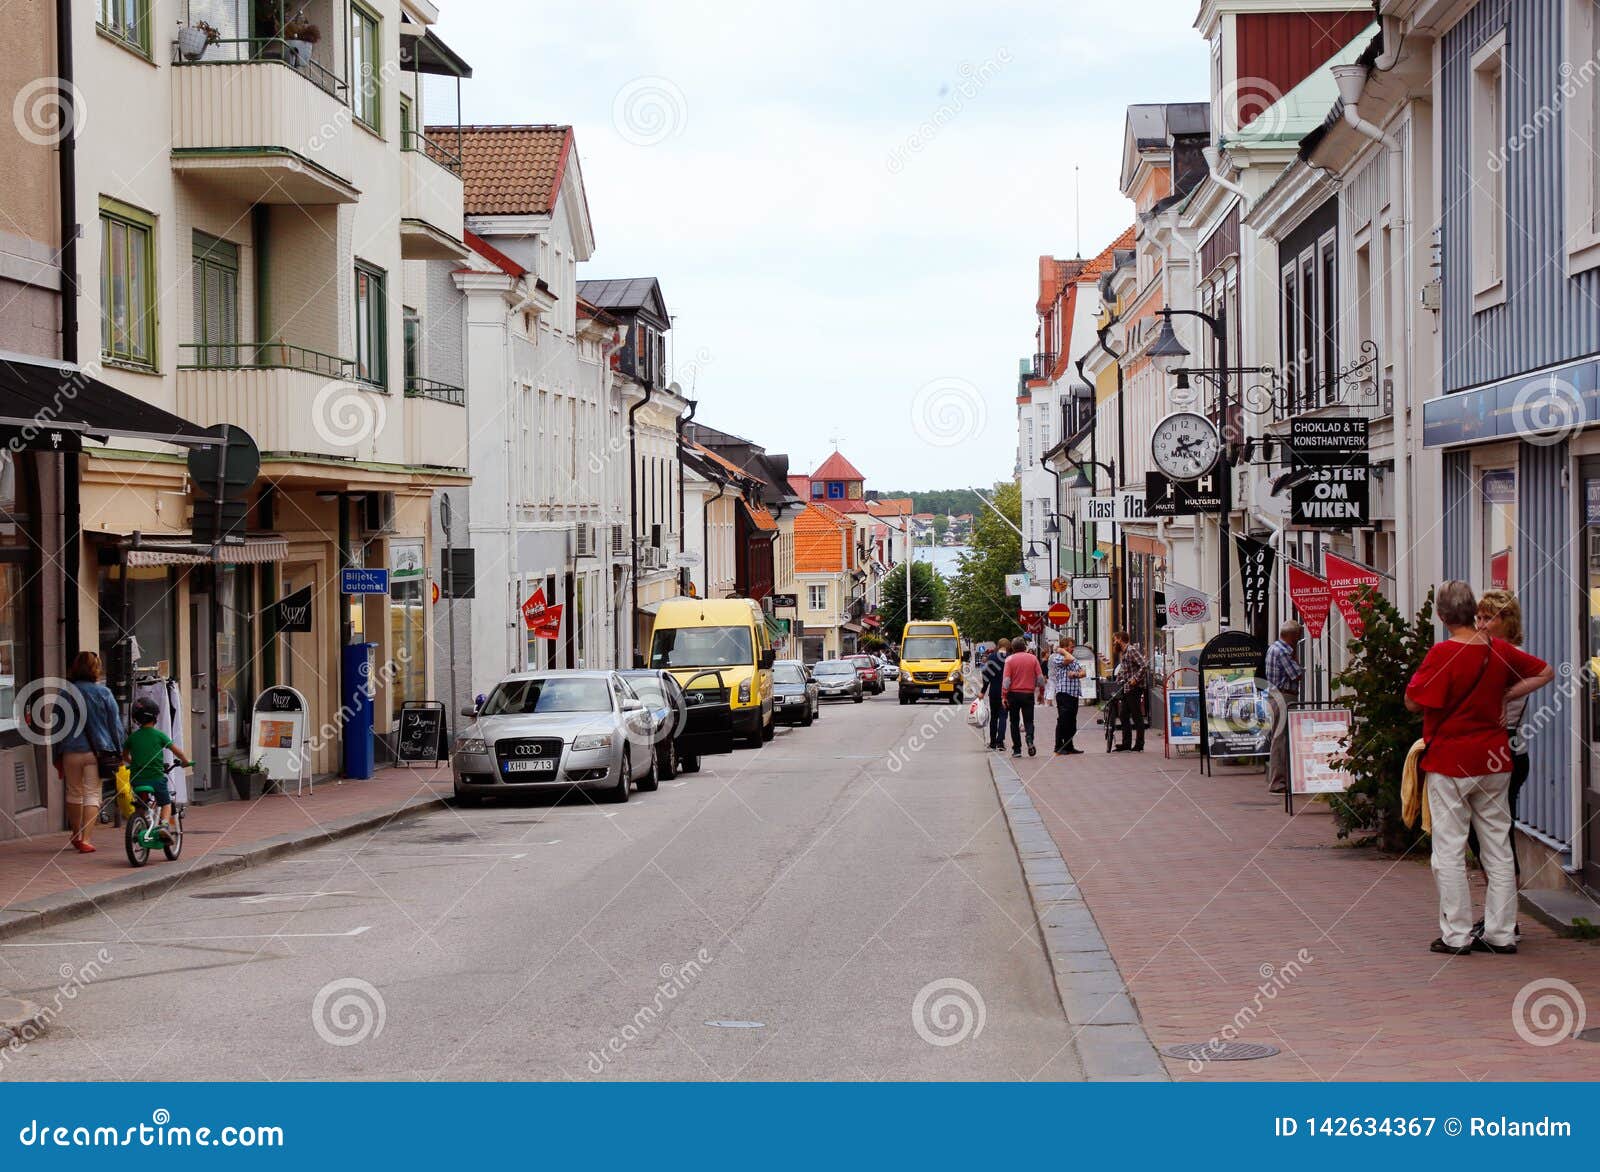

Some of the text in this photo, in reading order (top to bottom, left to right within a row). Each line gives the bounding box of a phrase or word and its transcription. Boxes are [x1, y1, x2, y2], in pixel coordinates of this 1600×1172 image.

[1294, 422, 1365, 432] CHOKLAD & TE
[1294, 435, 1365, 446] KONSTHANTVERK
[1314, 483, 1348, 499] OM
[1301, 501, 1360, 518] VIKEN
[1353, 576, 1378, 586] BUTIK
[281, 602, 306, 624] Razz
[510, 761, 552, 770] XHU 713
